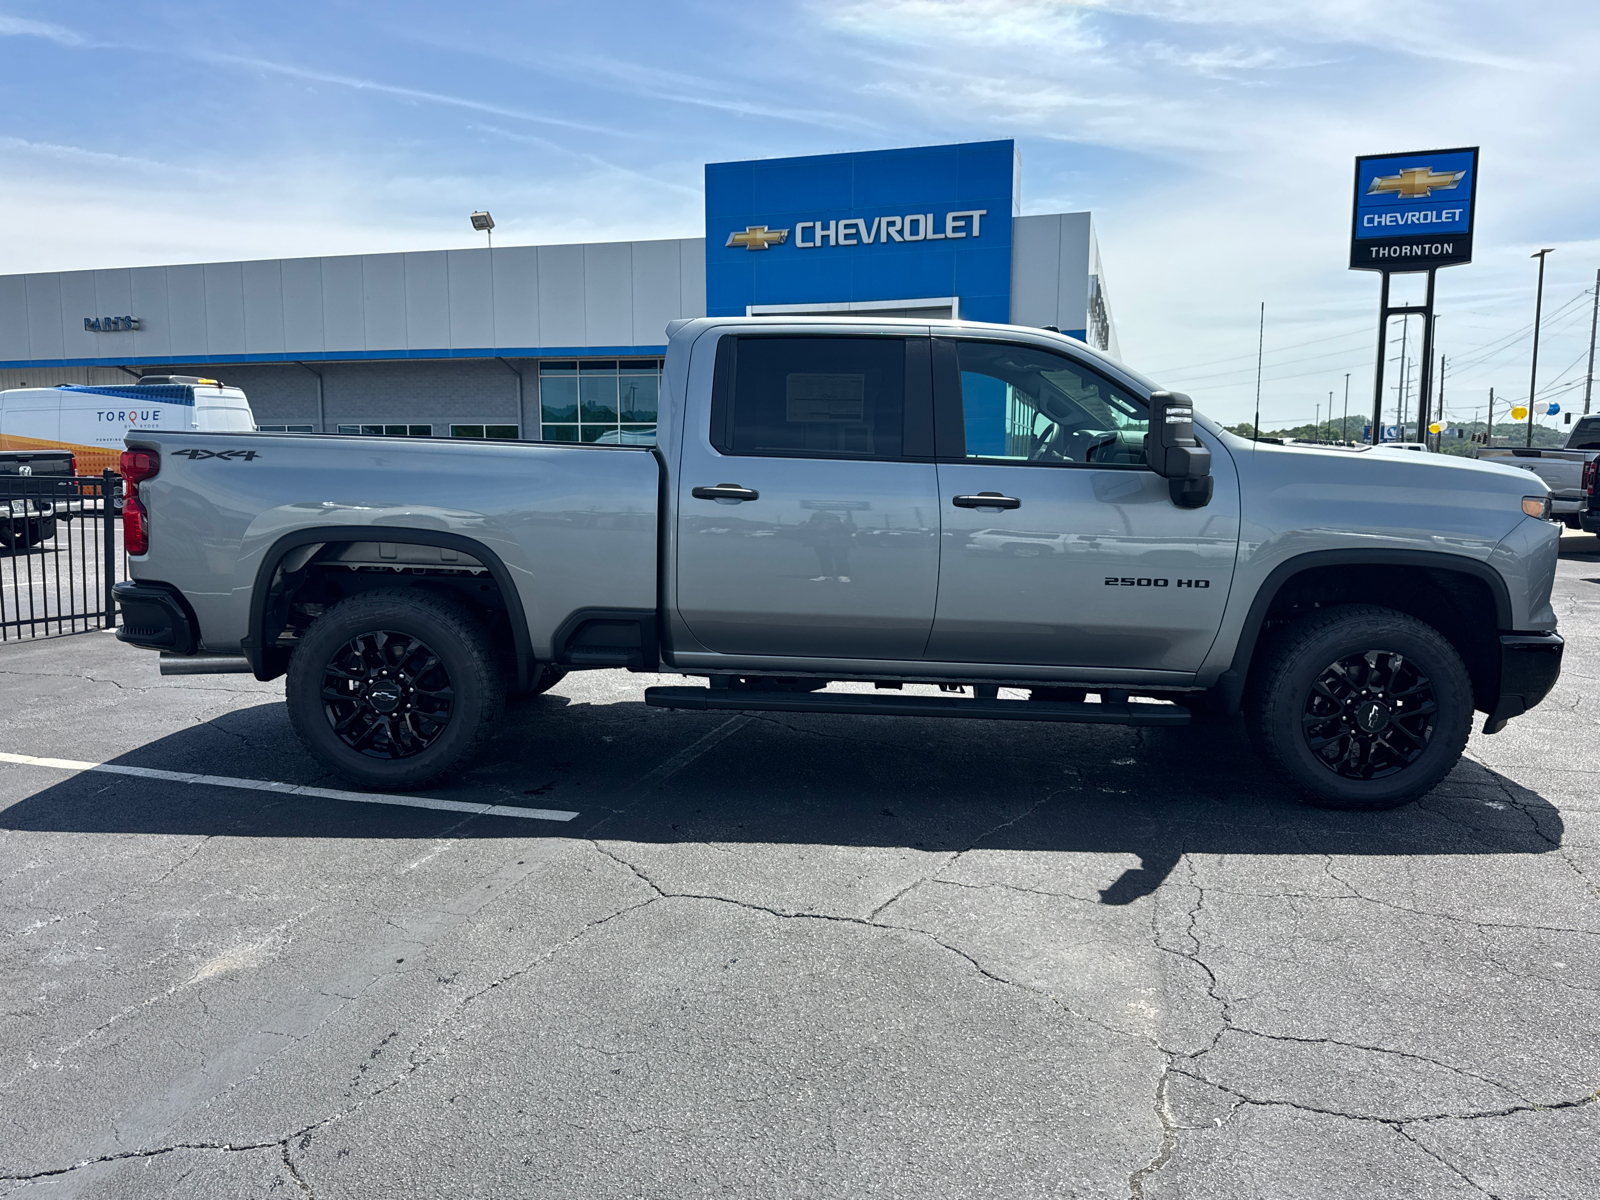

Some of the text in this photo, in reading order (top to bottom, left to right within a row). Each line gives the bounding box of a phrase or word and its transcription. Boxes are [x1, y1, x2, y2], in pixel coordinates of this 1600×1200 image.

[1363, 208, 1464, 228] CHEVROLET
[795, 209, 988, 249] CHEVROLET
[1370, 242, 1453, 259] THORNTON
[83, 314, 134, 332] PARTS
[96, 410, 161, 428] TORQUE
[1104, 577, 1210, 588] 2500 HD
